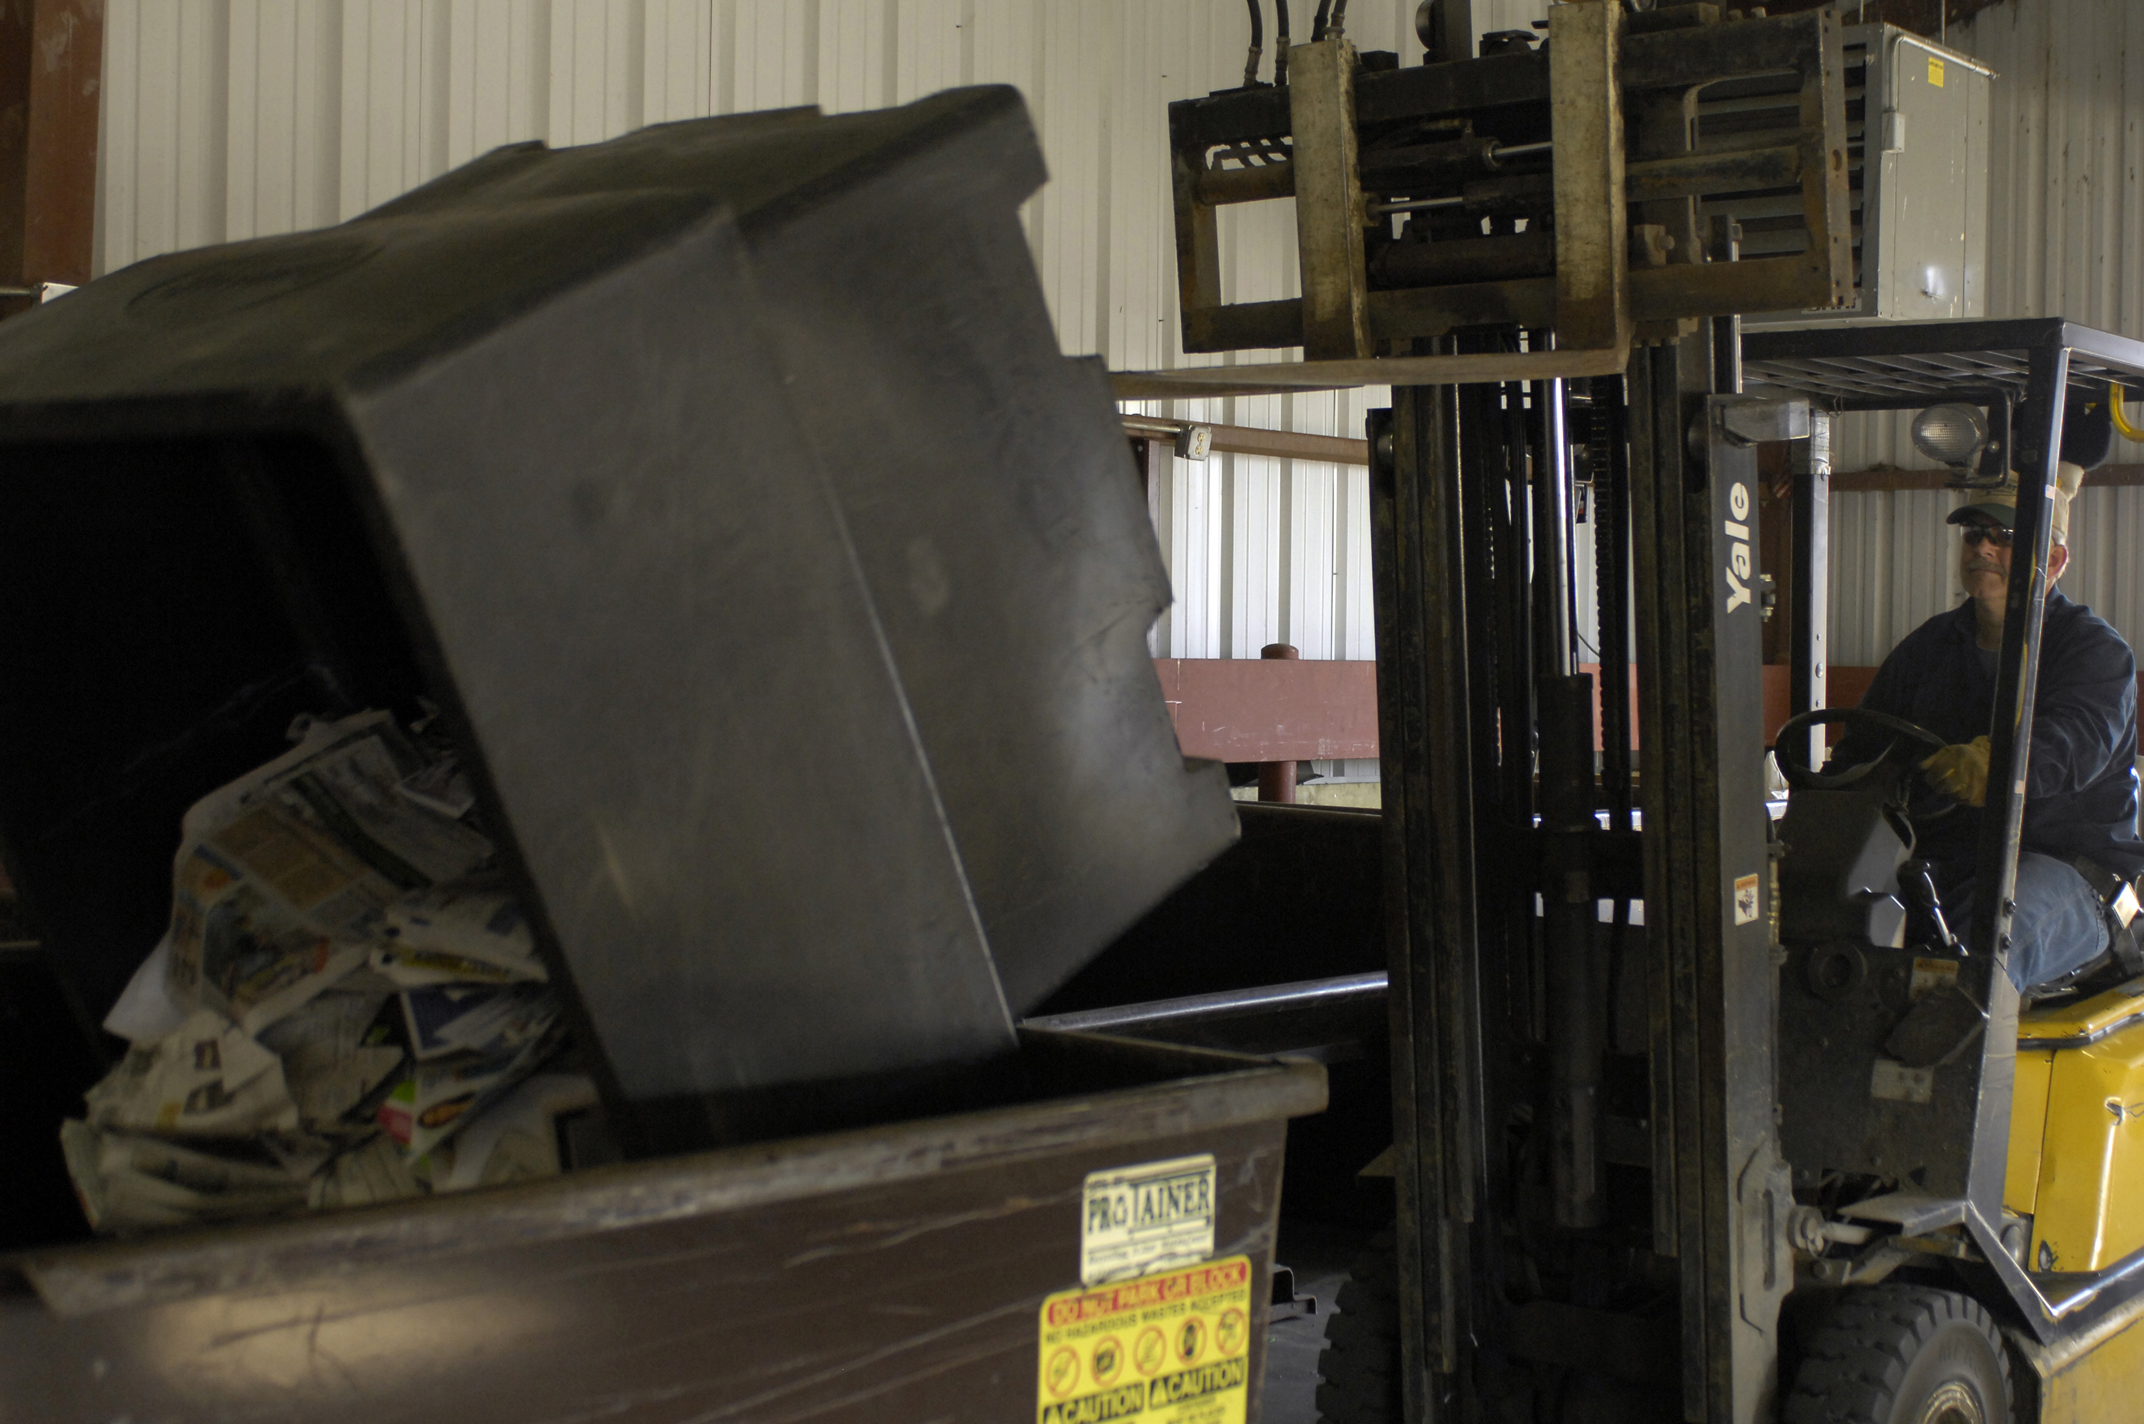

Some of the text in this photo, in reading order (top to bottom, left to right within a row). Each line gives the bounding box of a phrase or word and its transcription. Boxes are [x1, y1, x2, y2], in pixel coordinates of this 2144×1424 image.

[1725, 482, 1751, 614] Yale
[1189, 1263, 1242, 1295] BLOCK
[1167, 1358, 1244, 1401] CAUTION
[1061, 1385, 1144, 1424] CAUTION
